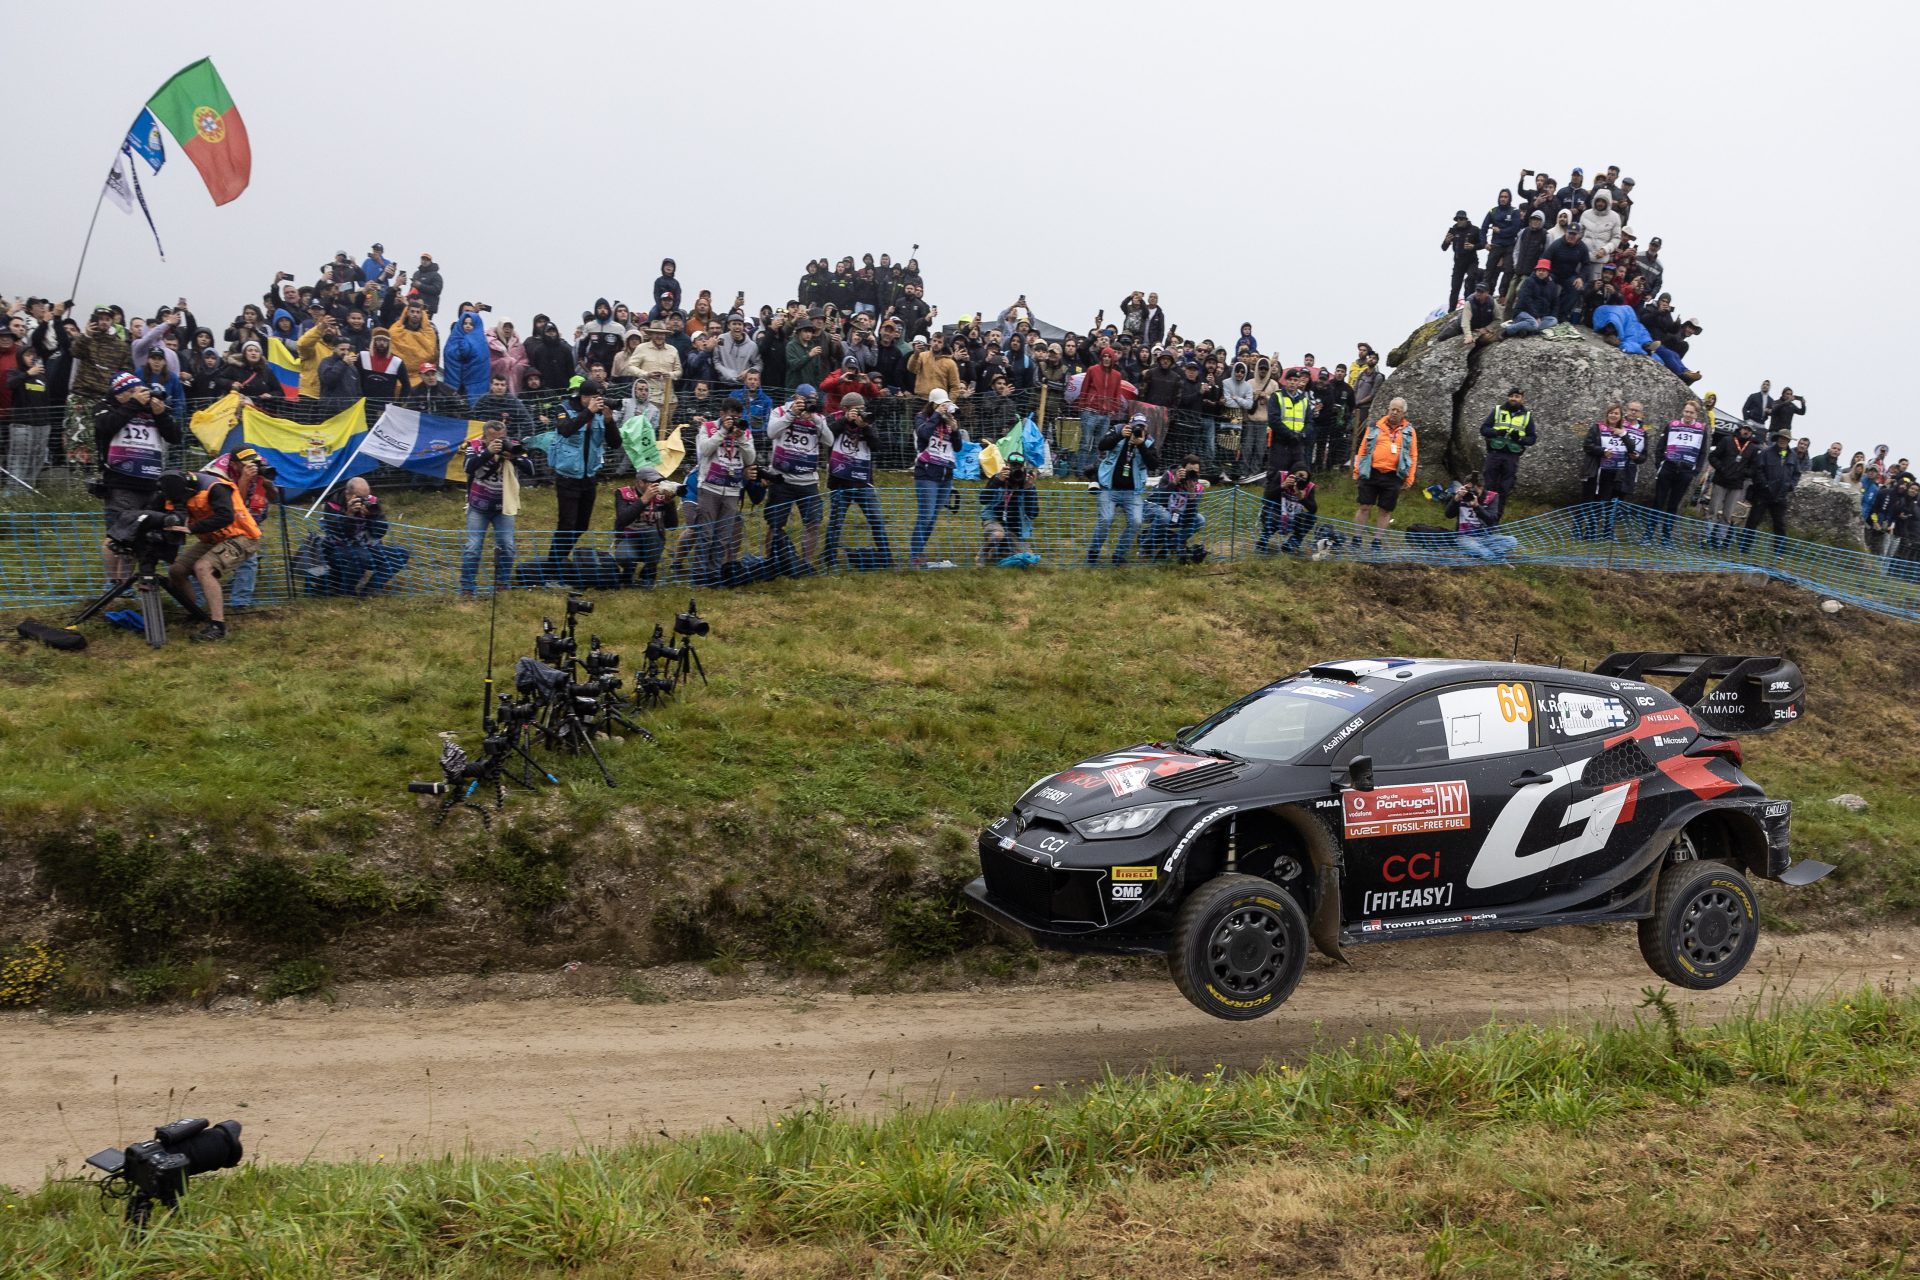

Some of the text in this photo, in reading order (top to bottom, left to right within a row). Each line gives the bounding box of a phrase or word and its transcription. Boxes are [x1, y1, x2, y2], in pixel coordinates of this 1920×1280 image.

[123, 427, 149, 440] 129
[1676, 433, 1693, 441] 431
[1770, 681, 1792, 690] SWS
[1497, 683, 1532, 723] 69
[1701, 705, 1745, 714] TAMADIC
[1774, 704, 1797, 719] Stilo
[1647, 714, 1680, 722] NISULA
[1663, 737, 1689, 745] Microsoft
[1316, 799, 1340, 808] PIAA
[1376, 796, 1436, 810] Portugal
[1440, 785, 1463, 813] HY
[1348, 810, 1372, 818] vodafone
[1765, 804, 1789, 816] ENDLESS
[1350, 818, 1465, 836] WRC FOSSIL-FREE FUEL
[1163, 805, 1239, 873] Panasonic
[1115, 869, 1153, 878] PIRELLI
[1112, 886, 1143, 898] OMP
[1711, 879, 1754, 920] SCORPION
[1362, 922, 1382, 932] GR
[1463, 913, 1497, 921] Racing
[1205, 982, 1272, 1008] SCORPION
